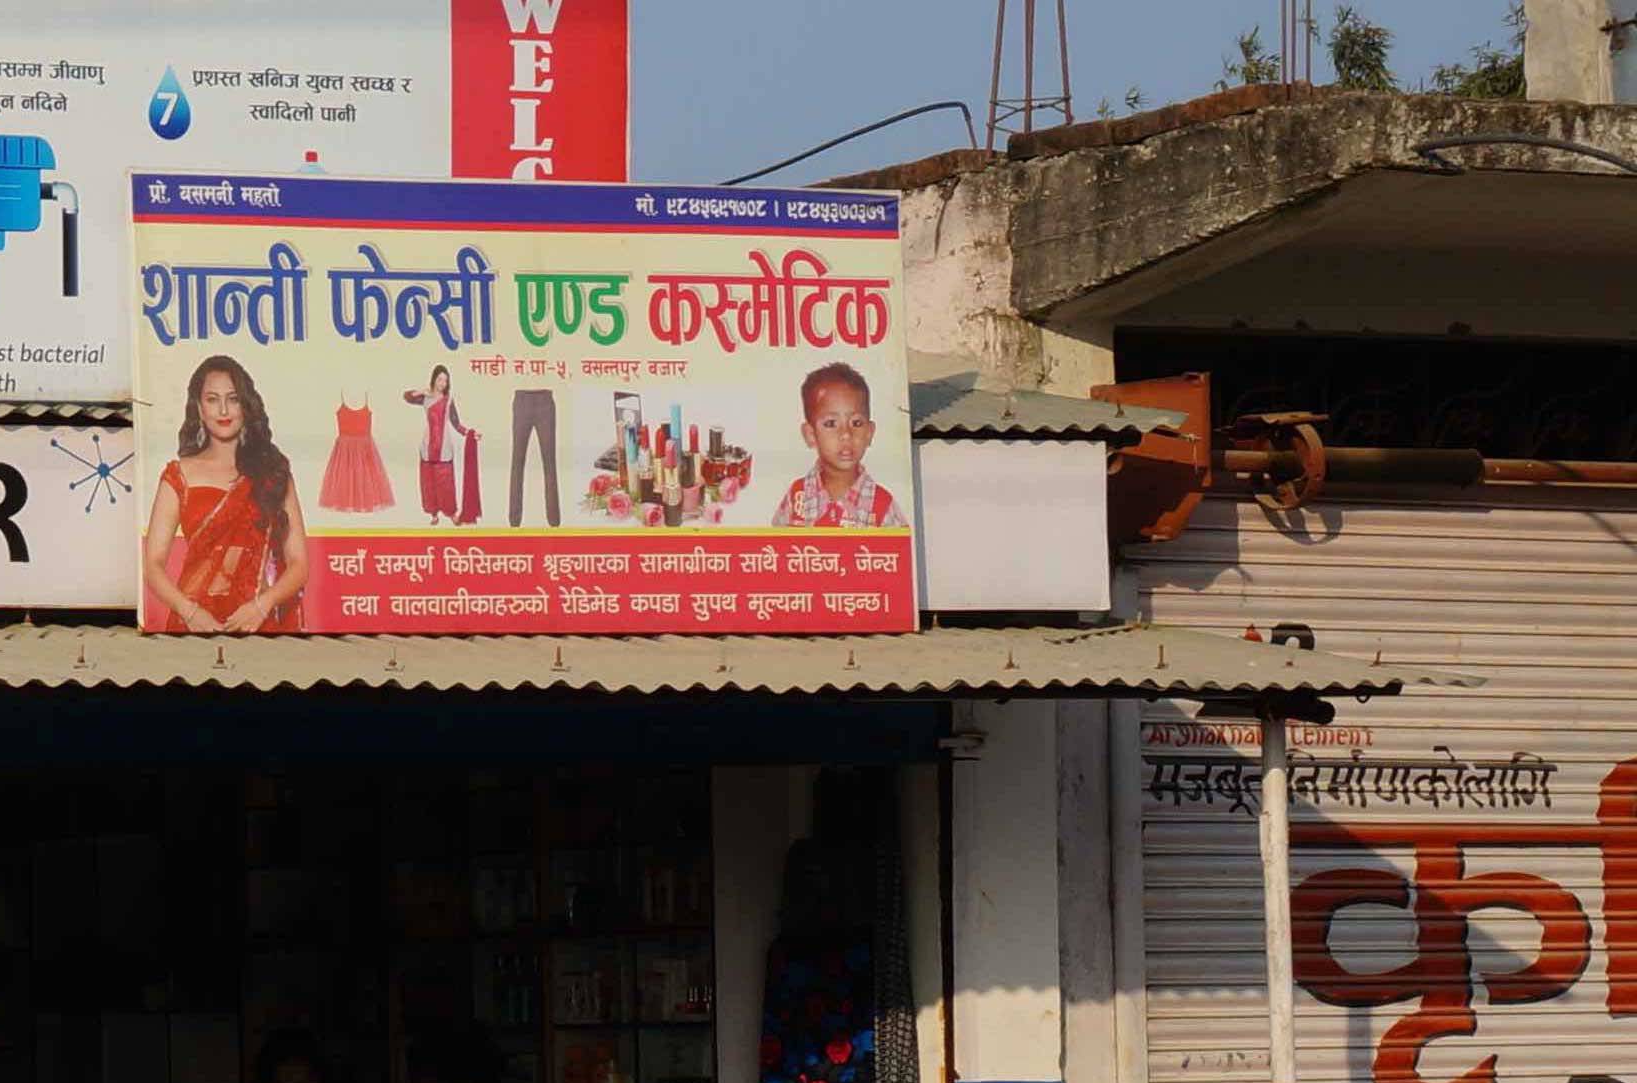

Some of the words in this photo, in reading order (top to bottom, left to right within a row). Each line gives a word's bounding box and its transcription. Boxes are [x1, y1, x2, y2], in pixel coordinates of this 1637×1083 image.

[50, 60, 105, 85] जीवाणु
[193, 71, 241, 87] प्रशस्त
[248, 68, 299, 88] खनिज
[306, 75, 343, 93] युक्त
[401, 79, 412, 93] र
[22, 91, 67, 112] नदिने
[156, 91, 179, 127] 7
[250, 101, 313, 121] स्वादिलो
[321, 104, 356, 122] पानी
[241, 183, 281, 208] महतो
[141, 240, 309, 348] शान्ती
[327, 243, 496, 352] फेन्सी
[513, 272, 630, 348] एण्ड
[646, 249, 891, 354] कस्मेटिक
[21, 343, 104, 363] bacterial
[328, 549, 367, 576] यहाँ
[374, 546, 435, 582] सम्पूर्ण
[443, 547, 533, 574] किसिमका
[739, 545, 779, 572] साथै
[854, 545, 899, 572] जेन्स
[341, 596, 380, 615] तथा
[559, 586, 620, 613] रेडिमेड
[630, 594, 680, 613] कपडा
[690, 594, 737, 621] सुपथ
[747, 593, 813, 620] मूल्यमा
